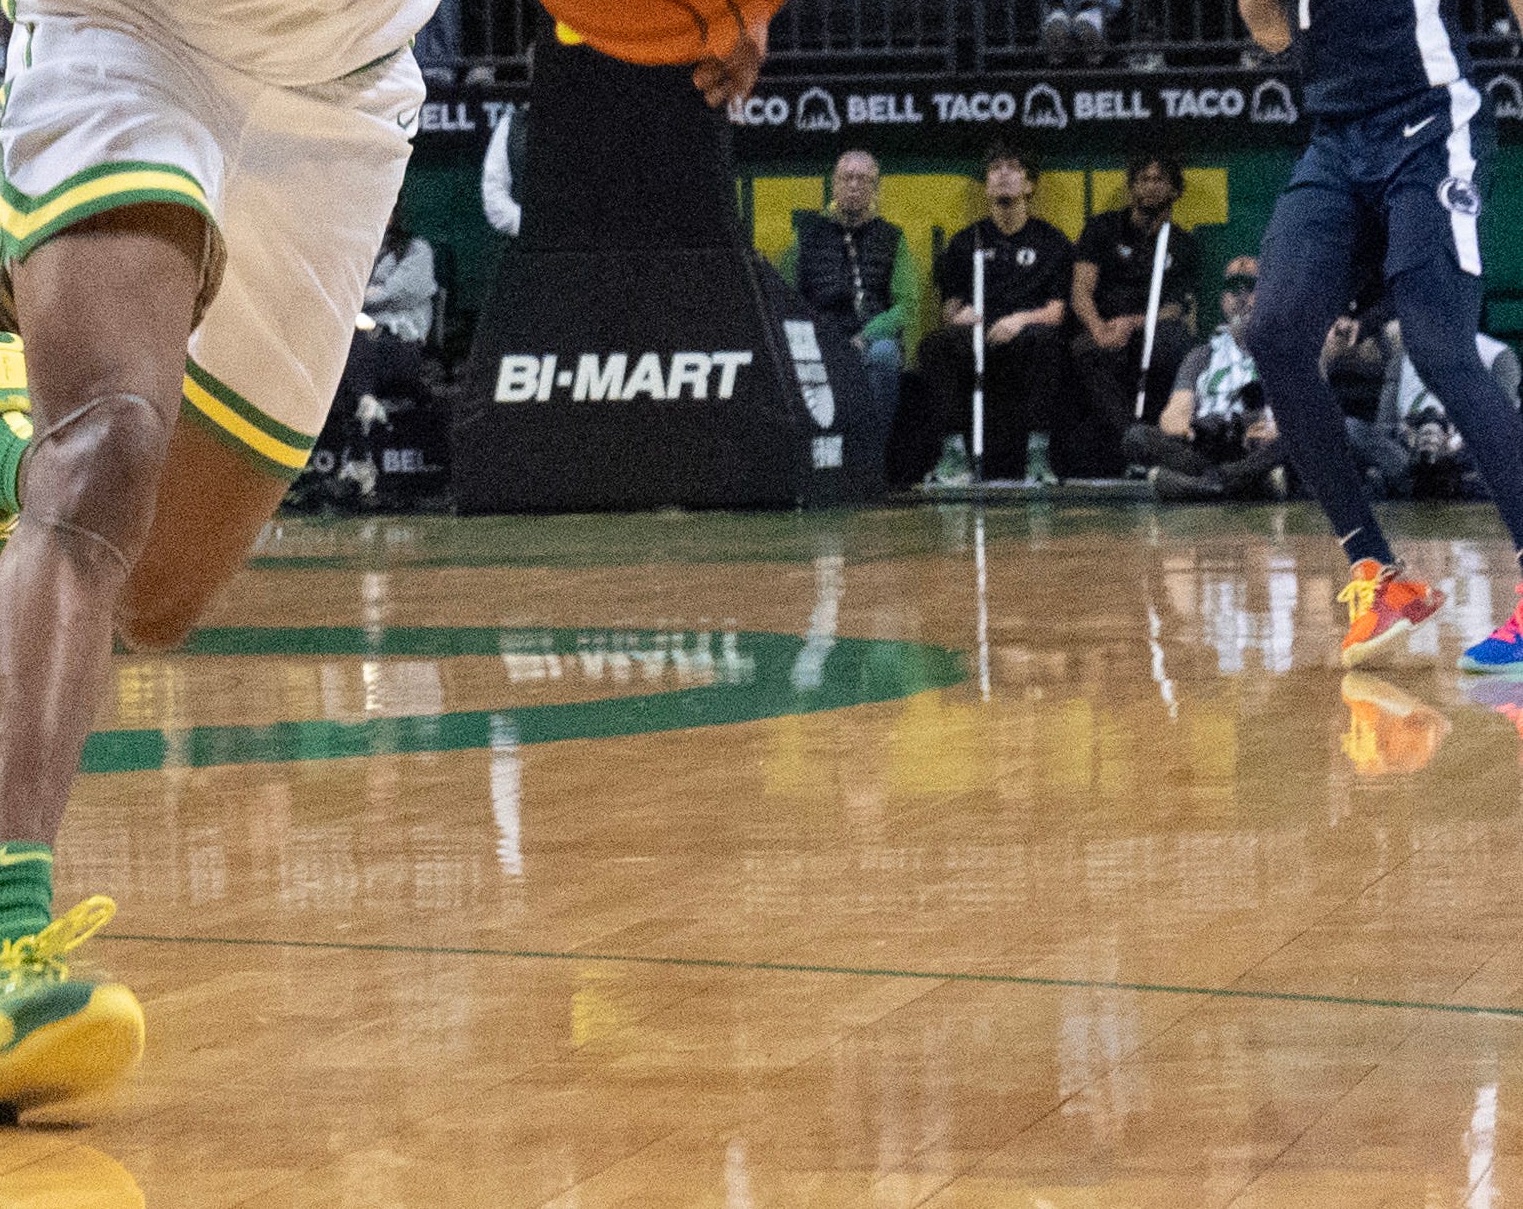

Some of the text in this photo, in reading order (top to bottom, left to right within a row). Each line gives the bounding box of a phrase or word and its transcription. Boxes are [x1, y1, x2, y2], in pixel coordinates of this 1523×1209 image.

[416, 103, 475, 132] ELL
[847, 91, 1017, 123] BELL TACO
[1075, 86, 1245, 120] BELL TACO
